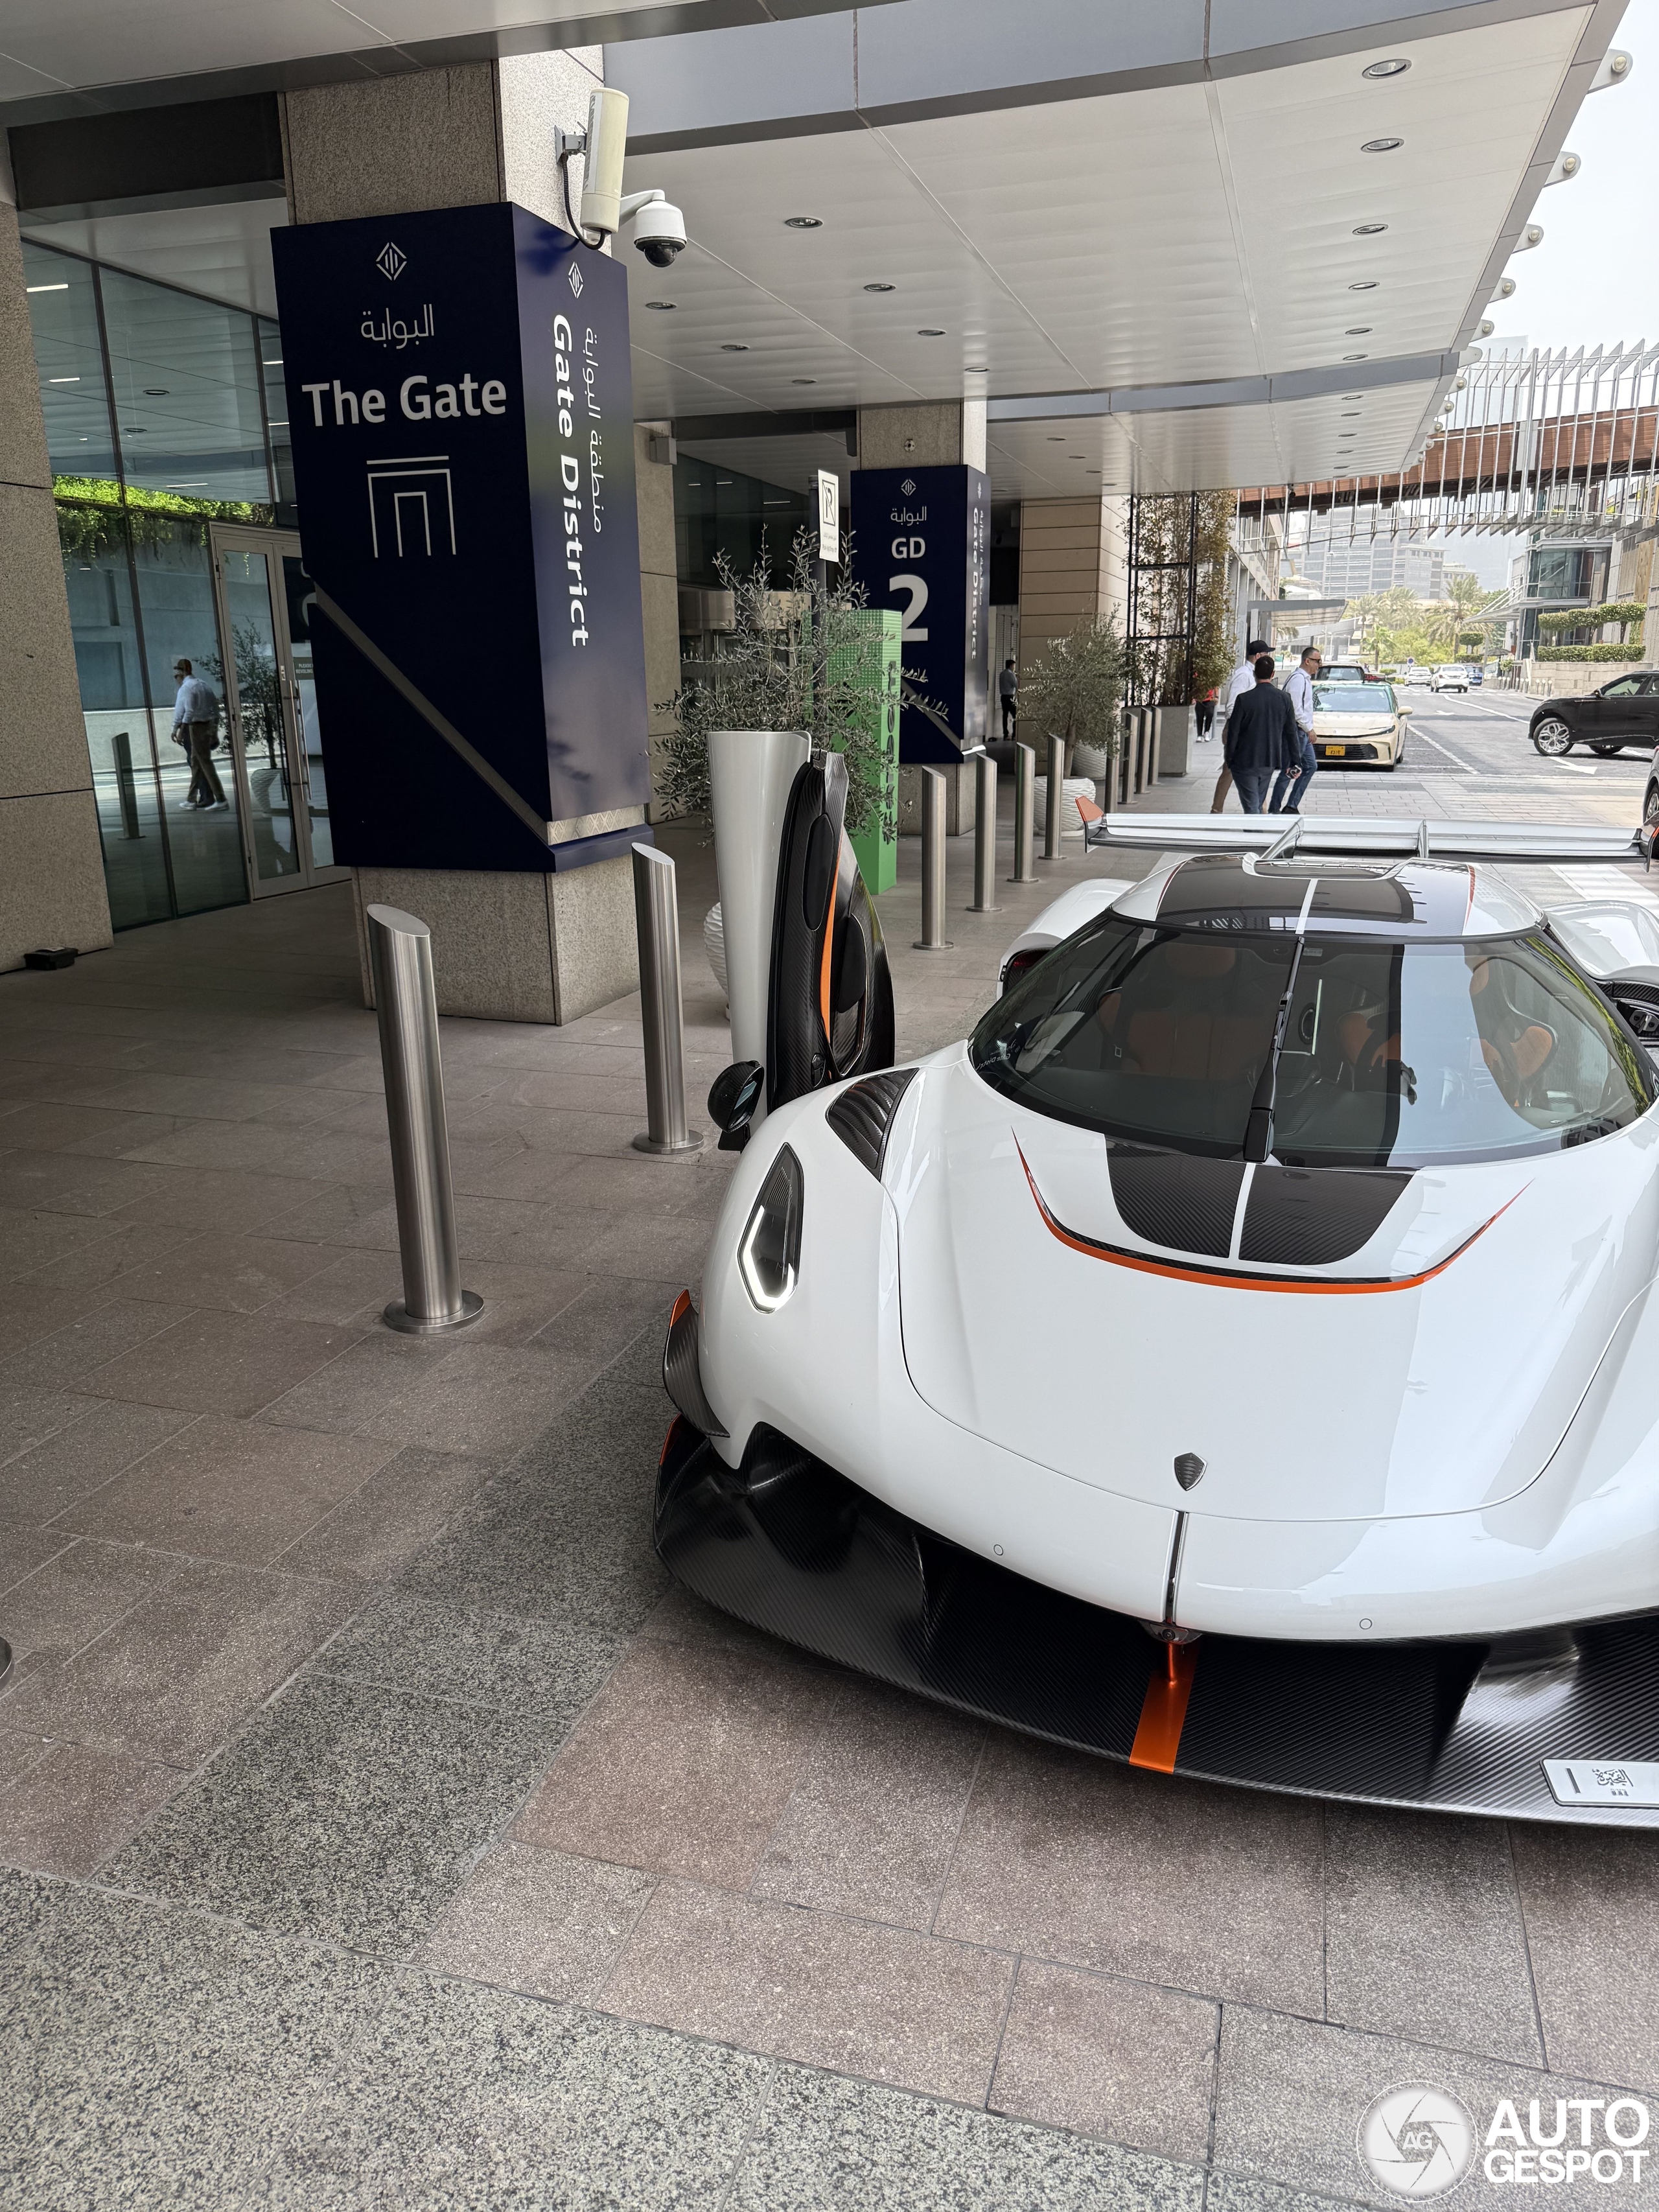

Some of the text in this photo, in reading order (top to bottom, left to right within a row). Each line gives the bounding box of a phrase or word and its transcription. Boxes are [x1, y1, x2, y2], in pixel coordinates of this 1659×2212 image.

[361, 304, 435, 349] البوابة
[302, 373, 507, 426] The Gate
[582, 327, 604, 533] منطقة البوابة
[553, 314, 589, 647] Gate District
[890, 506, 927, 526] البوابة
[891, 537, 926, 559] GD
[889, 574, 929, 642] 2
